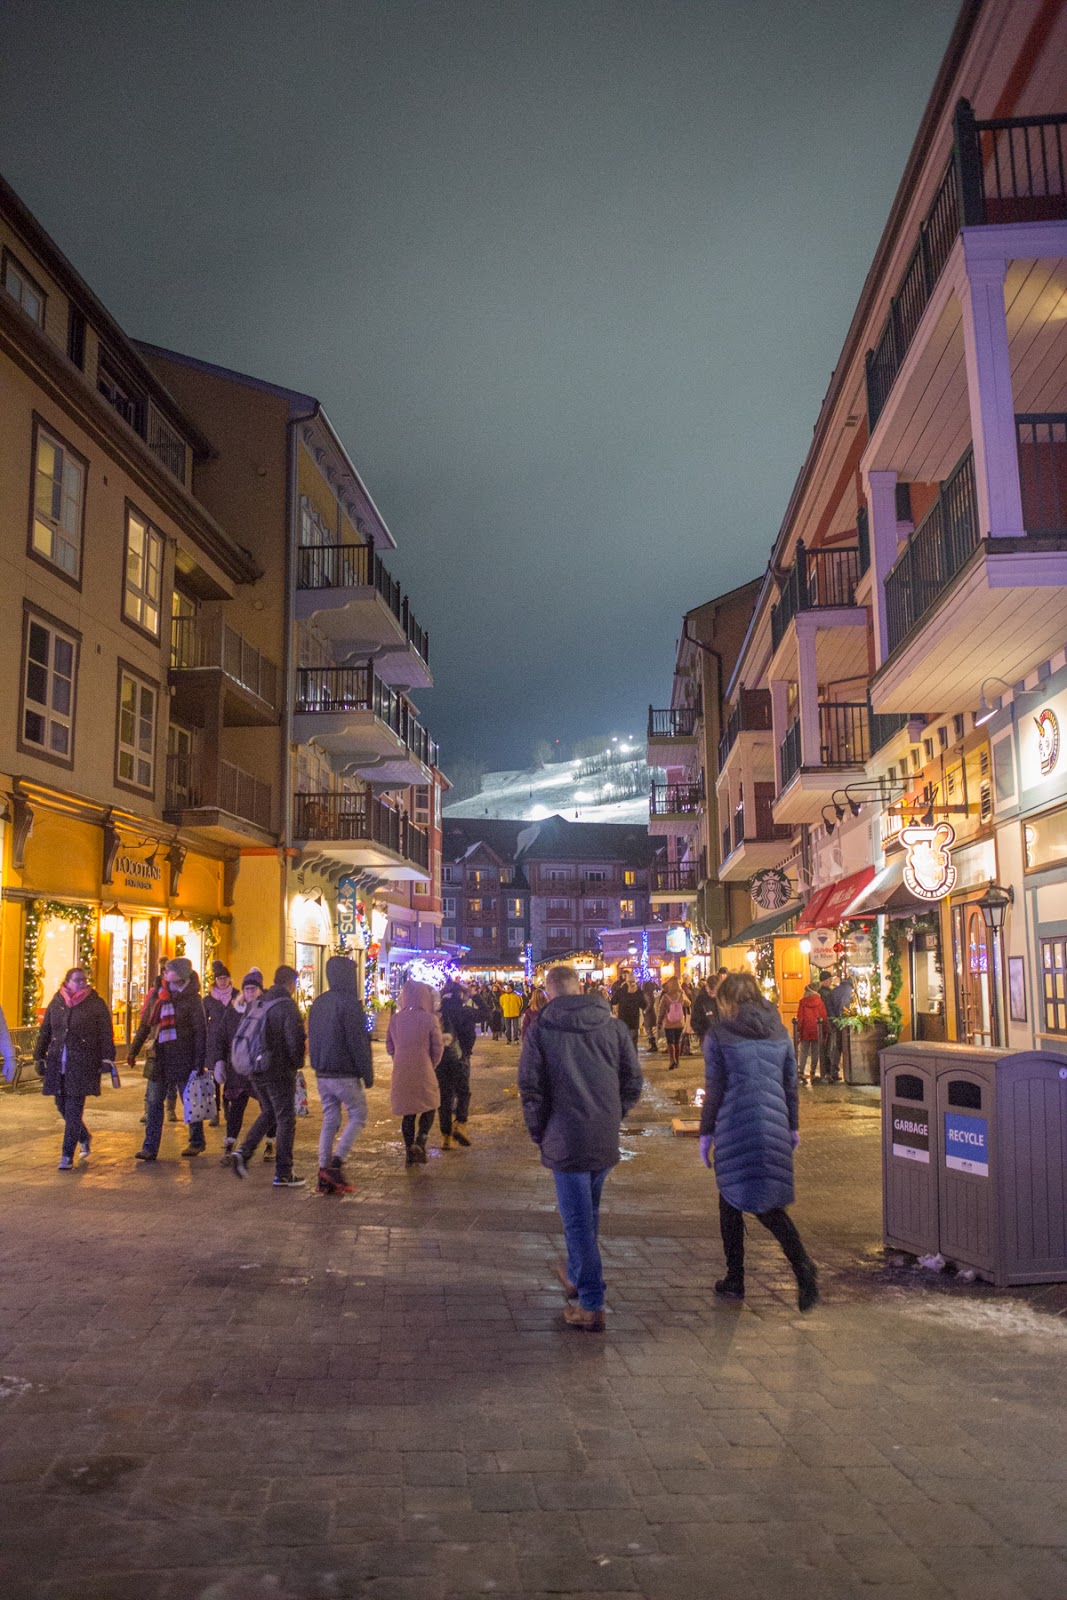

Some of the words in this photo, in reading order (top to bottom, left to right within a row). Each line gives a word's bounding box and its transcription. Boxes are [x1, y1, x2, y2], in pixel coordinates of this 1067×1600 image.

[340, 898, 354, 933] KIDS
[893, 1119, 928, 1136] GARBAGE
[948, 1129, 985, 1146] RECYCLE
